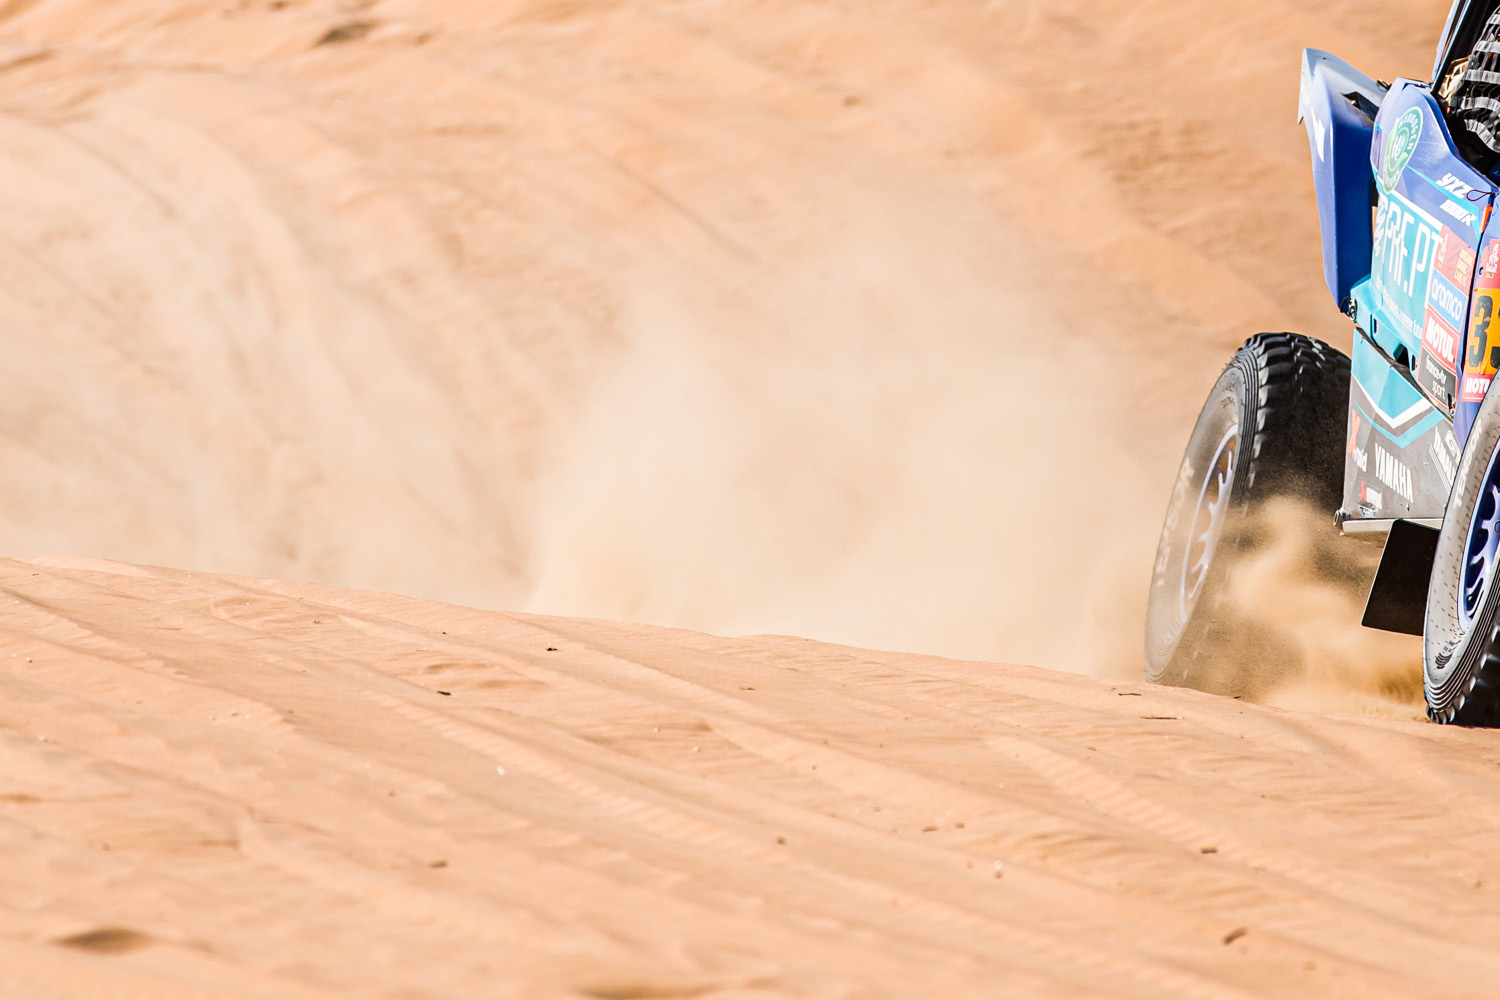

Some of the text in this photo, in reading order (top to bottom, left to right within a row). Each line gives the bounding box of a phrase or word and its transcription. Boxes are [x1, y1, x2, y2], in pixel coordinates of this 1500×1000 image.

[1435, 172, 1475, 199] YXZ
[1431, 278, 1463, 321] aramco
[1425, 316, 1455, 364] MOTUL
[1432, 380, 1447, 400] sport
[1465, 377, 1491, 395] MOTU
[1375, 442, 1414, 504] YAMAHA
